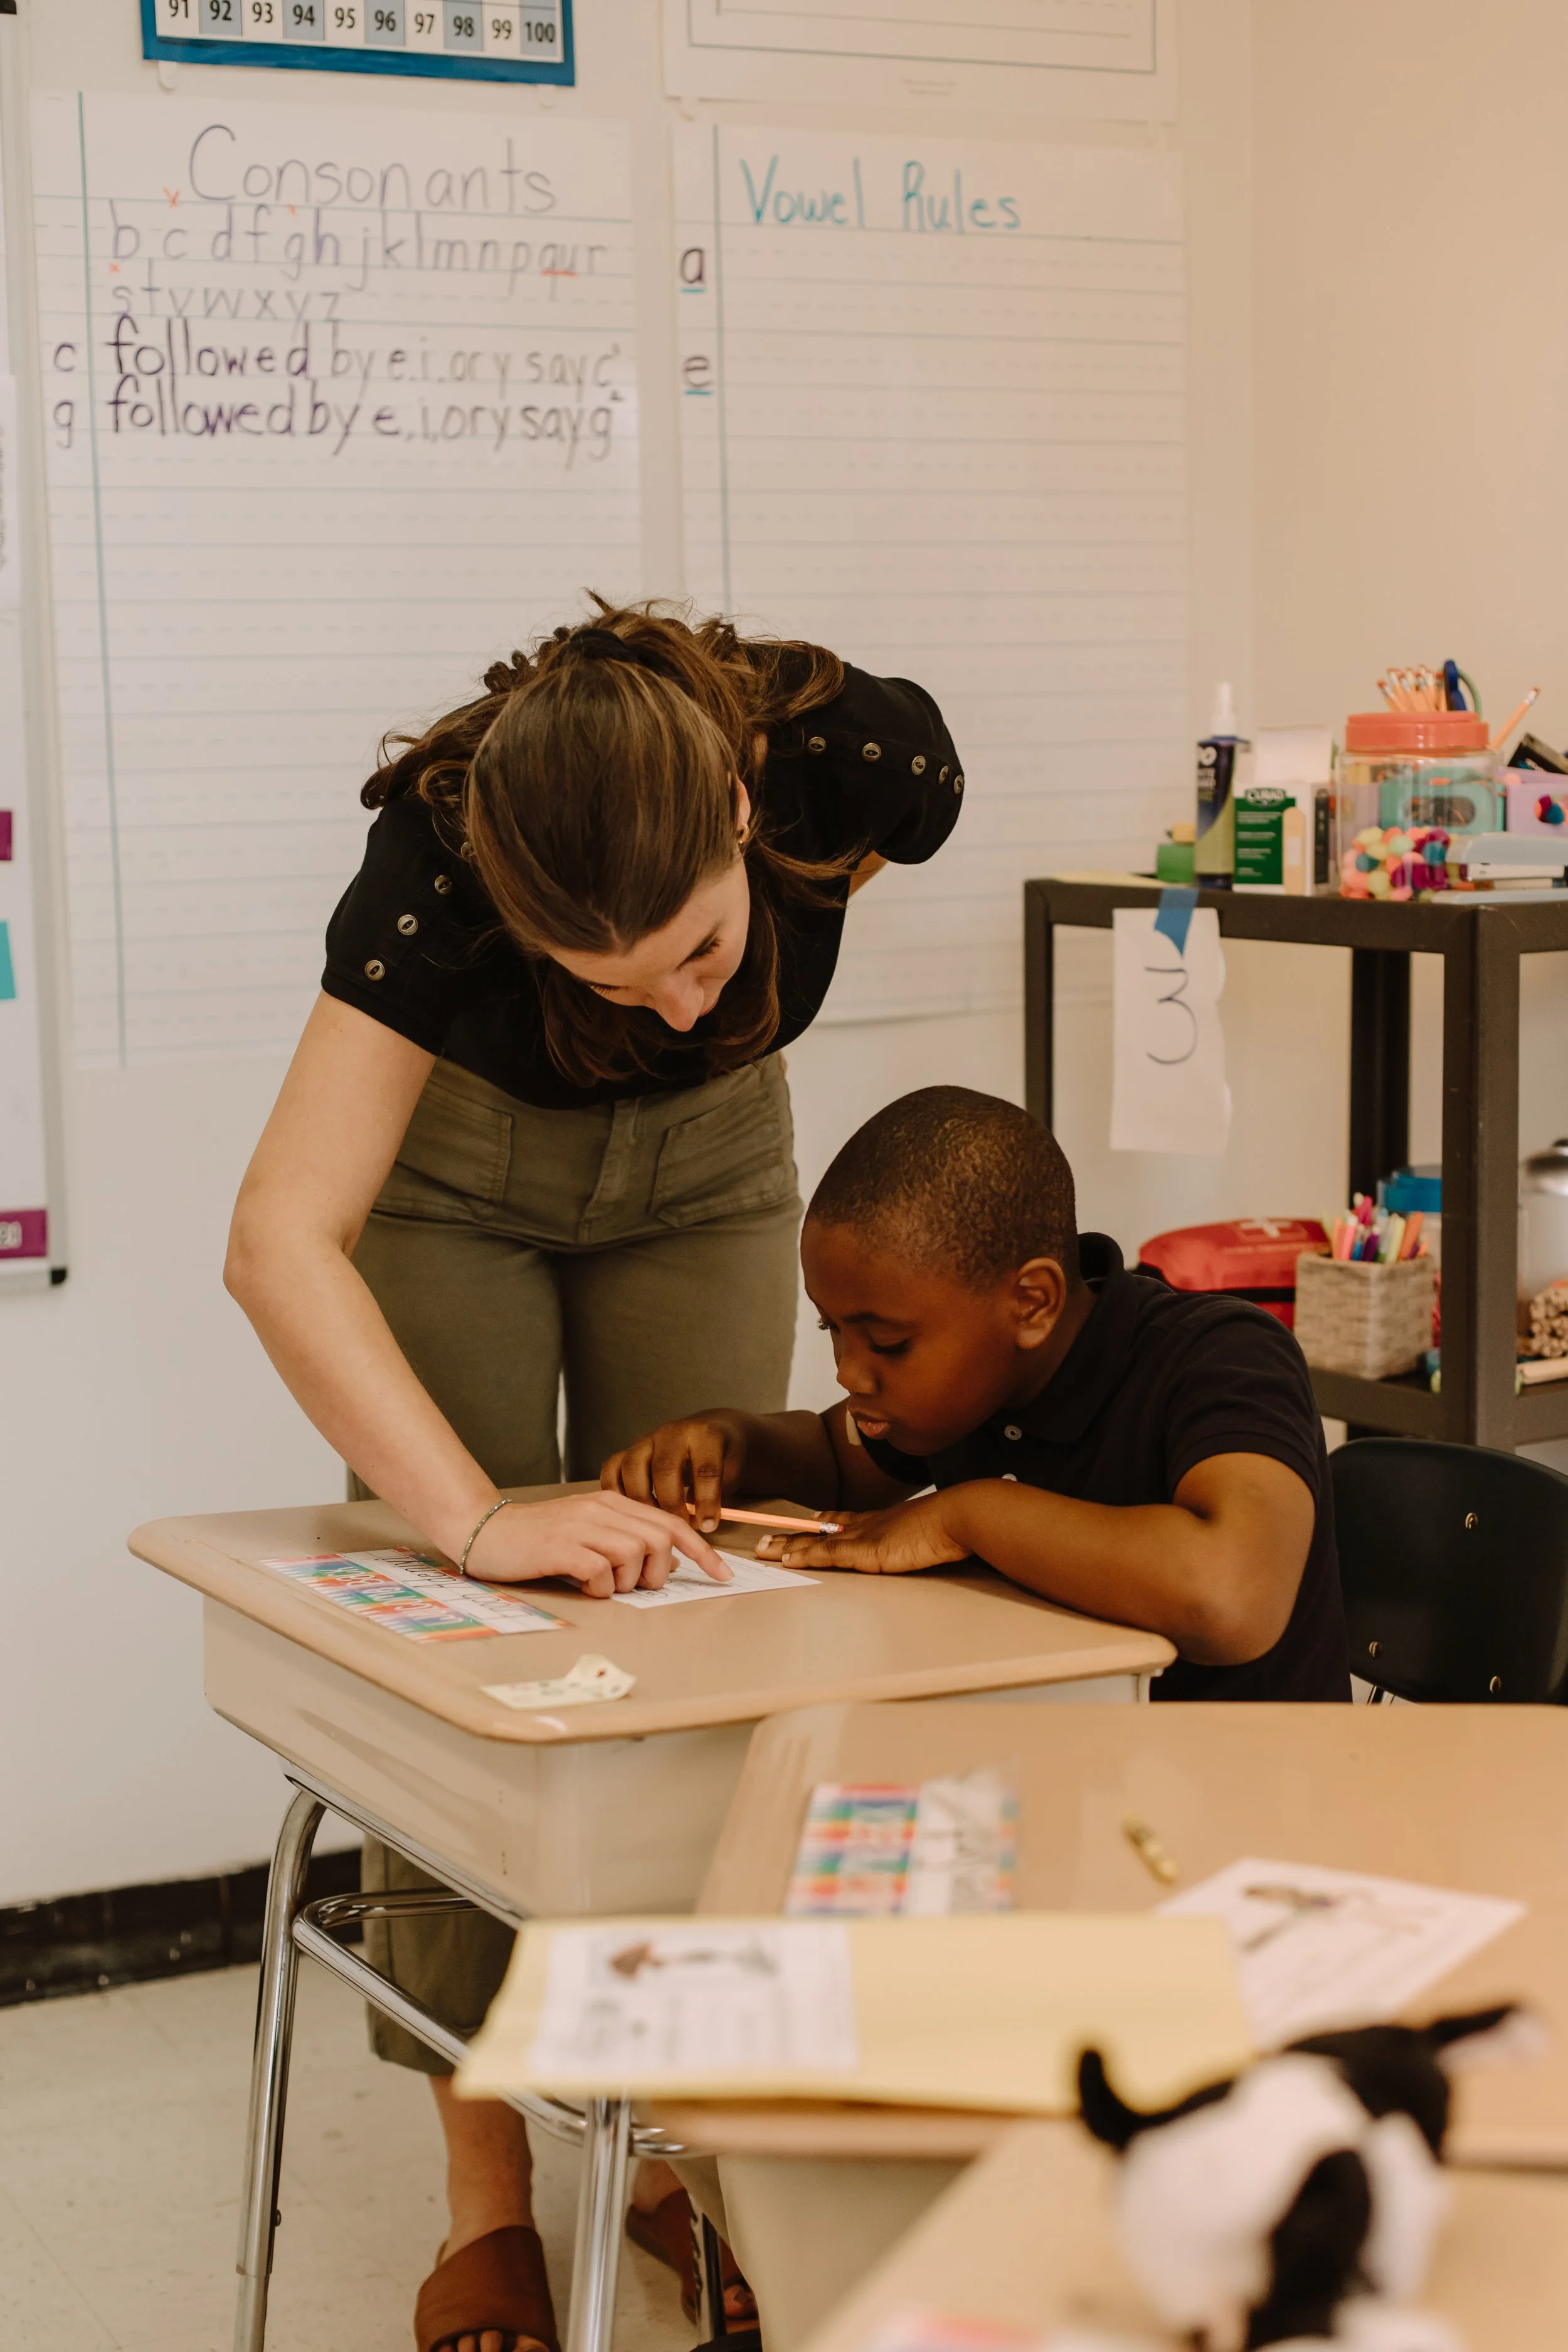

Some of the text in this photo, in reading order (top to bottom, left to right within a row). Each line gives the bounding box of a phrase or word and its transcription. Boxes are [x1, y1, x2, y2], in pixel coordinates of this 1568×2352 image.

[169, 0, 556, 42] 91 92 93 94 95 96 97 98 99 100
[189, 124, 557, 213] Consonants
[739, 155, 1021, 235] Vowel Rules
[679, 247, 706, 285] a
[53, 342, 76, 372] c
[105, 314, 310, 376] followed
[682, 355, 711, 389] e
[53, 401, 75, 449] g
[108, 374, 295, 437] followed
[1144, 967, 1198, 1065] 3
